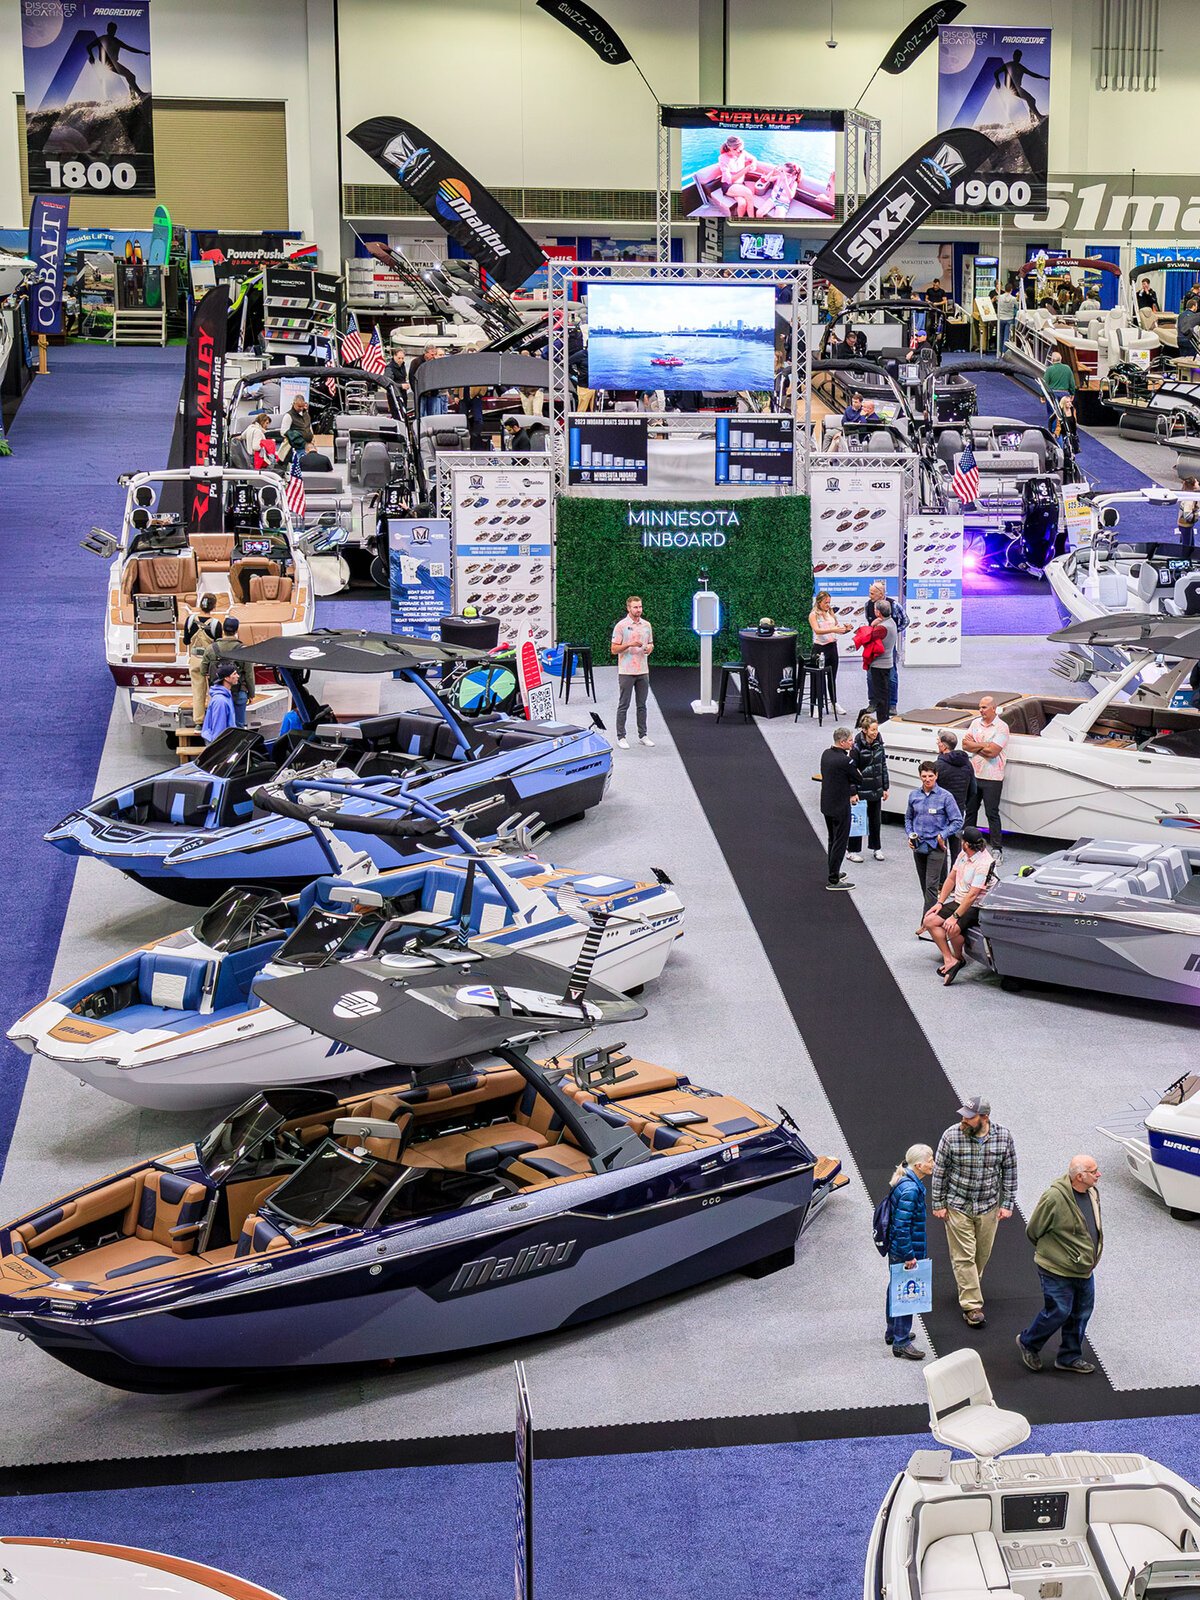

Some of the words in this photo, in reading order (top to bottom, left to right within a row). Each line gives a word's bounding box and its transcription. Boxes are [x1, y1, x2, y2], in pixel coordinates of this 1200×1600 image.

[24, 2, 77, 11] DISCOVER
[25, 9, 73, 18] BOATING
[92, 7, 144, 17] PROGRESSIVE
[942, 31, 988, 39] DISCOVER
[942, 37, 983, 46] BOATING
[1001, 36, 1046, 45] PROGRESSIVE
[704, 108, 751, 124] RIVER
[754, 113, 804, 125] VALLEY
[45, 161, 137, 190] 1800
[954, 179, 1032, 207] 1900
[447, 197, 511, 257] Malibu
[1140, 253, 1174, 265] Take
[37, 212, 61, 327] COBALT
[196, 326, 215, 427] VALLEY
[190, 431, 211, 523] RIER
[628, 510, 740, 527] MINNESOTA
[642, 532, 726, 548] INBOARD
[448, 1239, 577, 1293] Malibu
